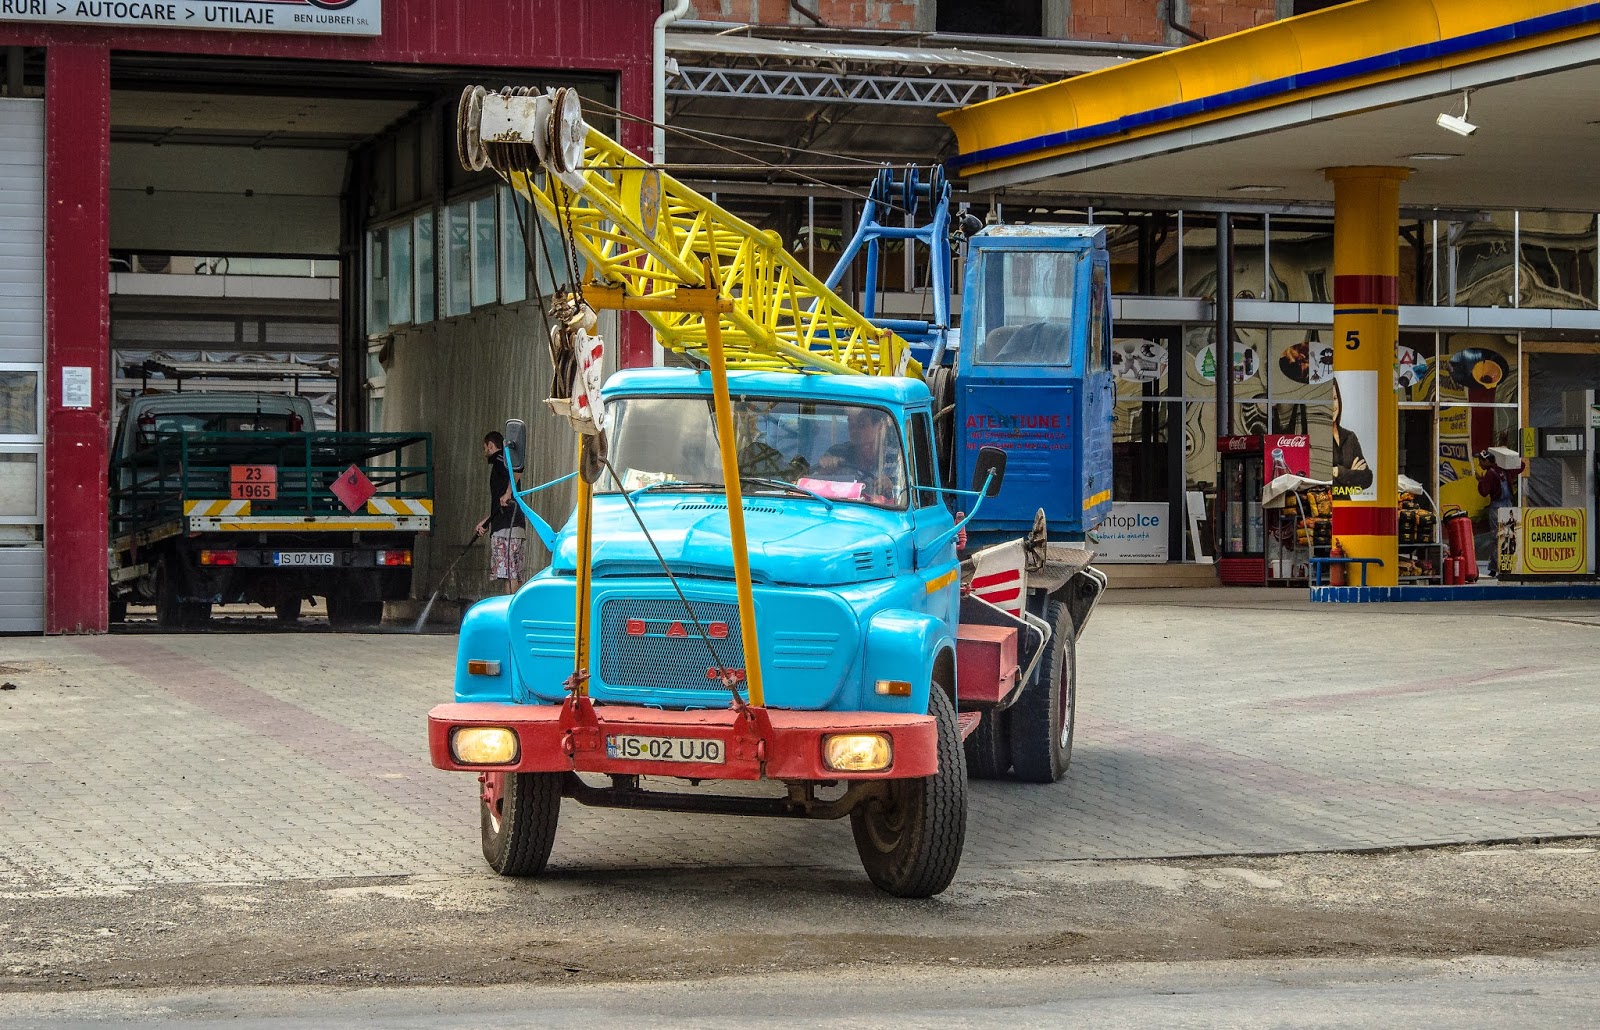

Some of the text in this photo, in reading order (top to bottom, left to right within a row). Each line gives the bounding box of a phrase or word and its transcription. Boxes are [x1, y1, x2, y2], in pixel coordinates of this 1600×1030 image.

[76, 1, 176, 20] AUTOCARE
[205, 6, 274, 25] UTILAJE
[294, 14, 369, 26] BEN LUBREFI SRL
[1345, 330, 1360, 350] 5
[1277, 436, 1307, 447] Coca-Cola
[246, 468, 262, 480] 23
[238, 485, 270, 497] 1965
[1100, 514, 1160, 530] ntopIce
[1531, 532, 1577, 543] CARBURANT
[281, 554, 332, 564] IS 07 MTG
[1532, 547, 1577, 562] INDUSTRY
[621, 738, 641, 757] IS
[649, 740, 673, 758] 02
[680, 741, 719, 761] UJO
